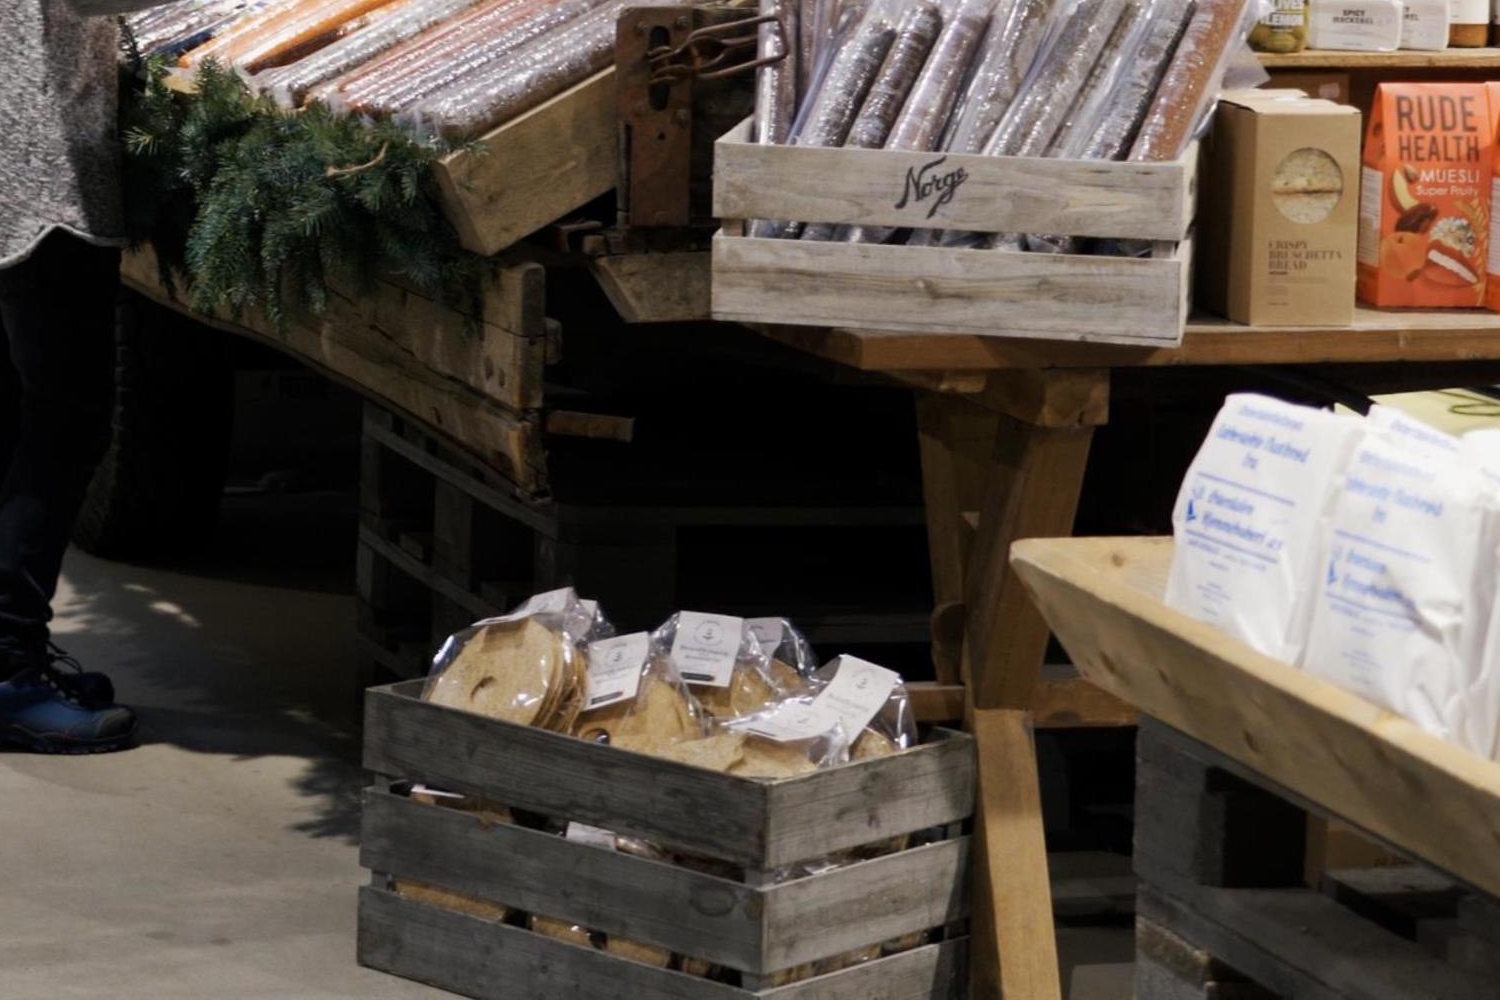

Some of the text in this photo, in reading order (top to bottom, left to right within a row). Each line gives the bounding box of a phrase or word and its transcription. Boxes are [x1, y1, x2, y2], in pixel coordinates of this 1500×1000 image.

[1342, 9, 1366, 17] SPICY
[1396, 95, 1478, 132] RUDE
[1398, 135, 1480, 162] HEALTH
[1420, 169, 1480, 183] MUESLI
[894, 154, 969, 219] Norge
[1415, 185, 1479, 198] Super Fruity
